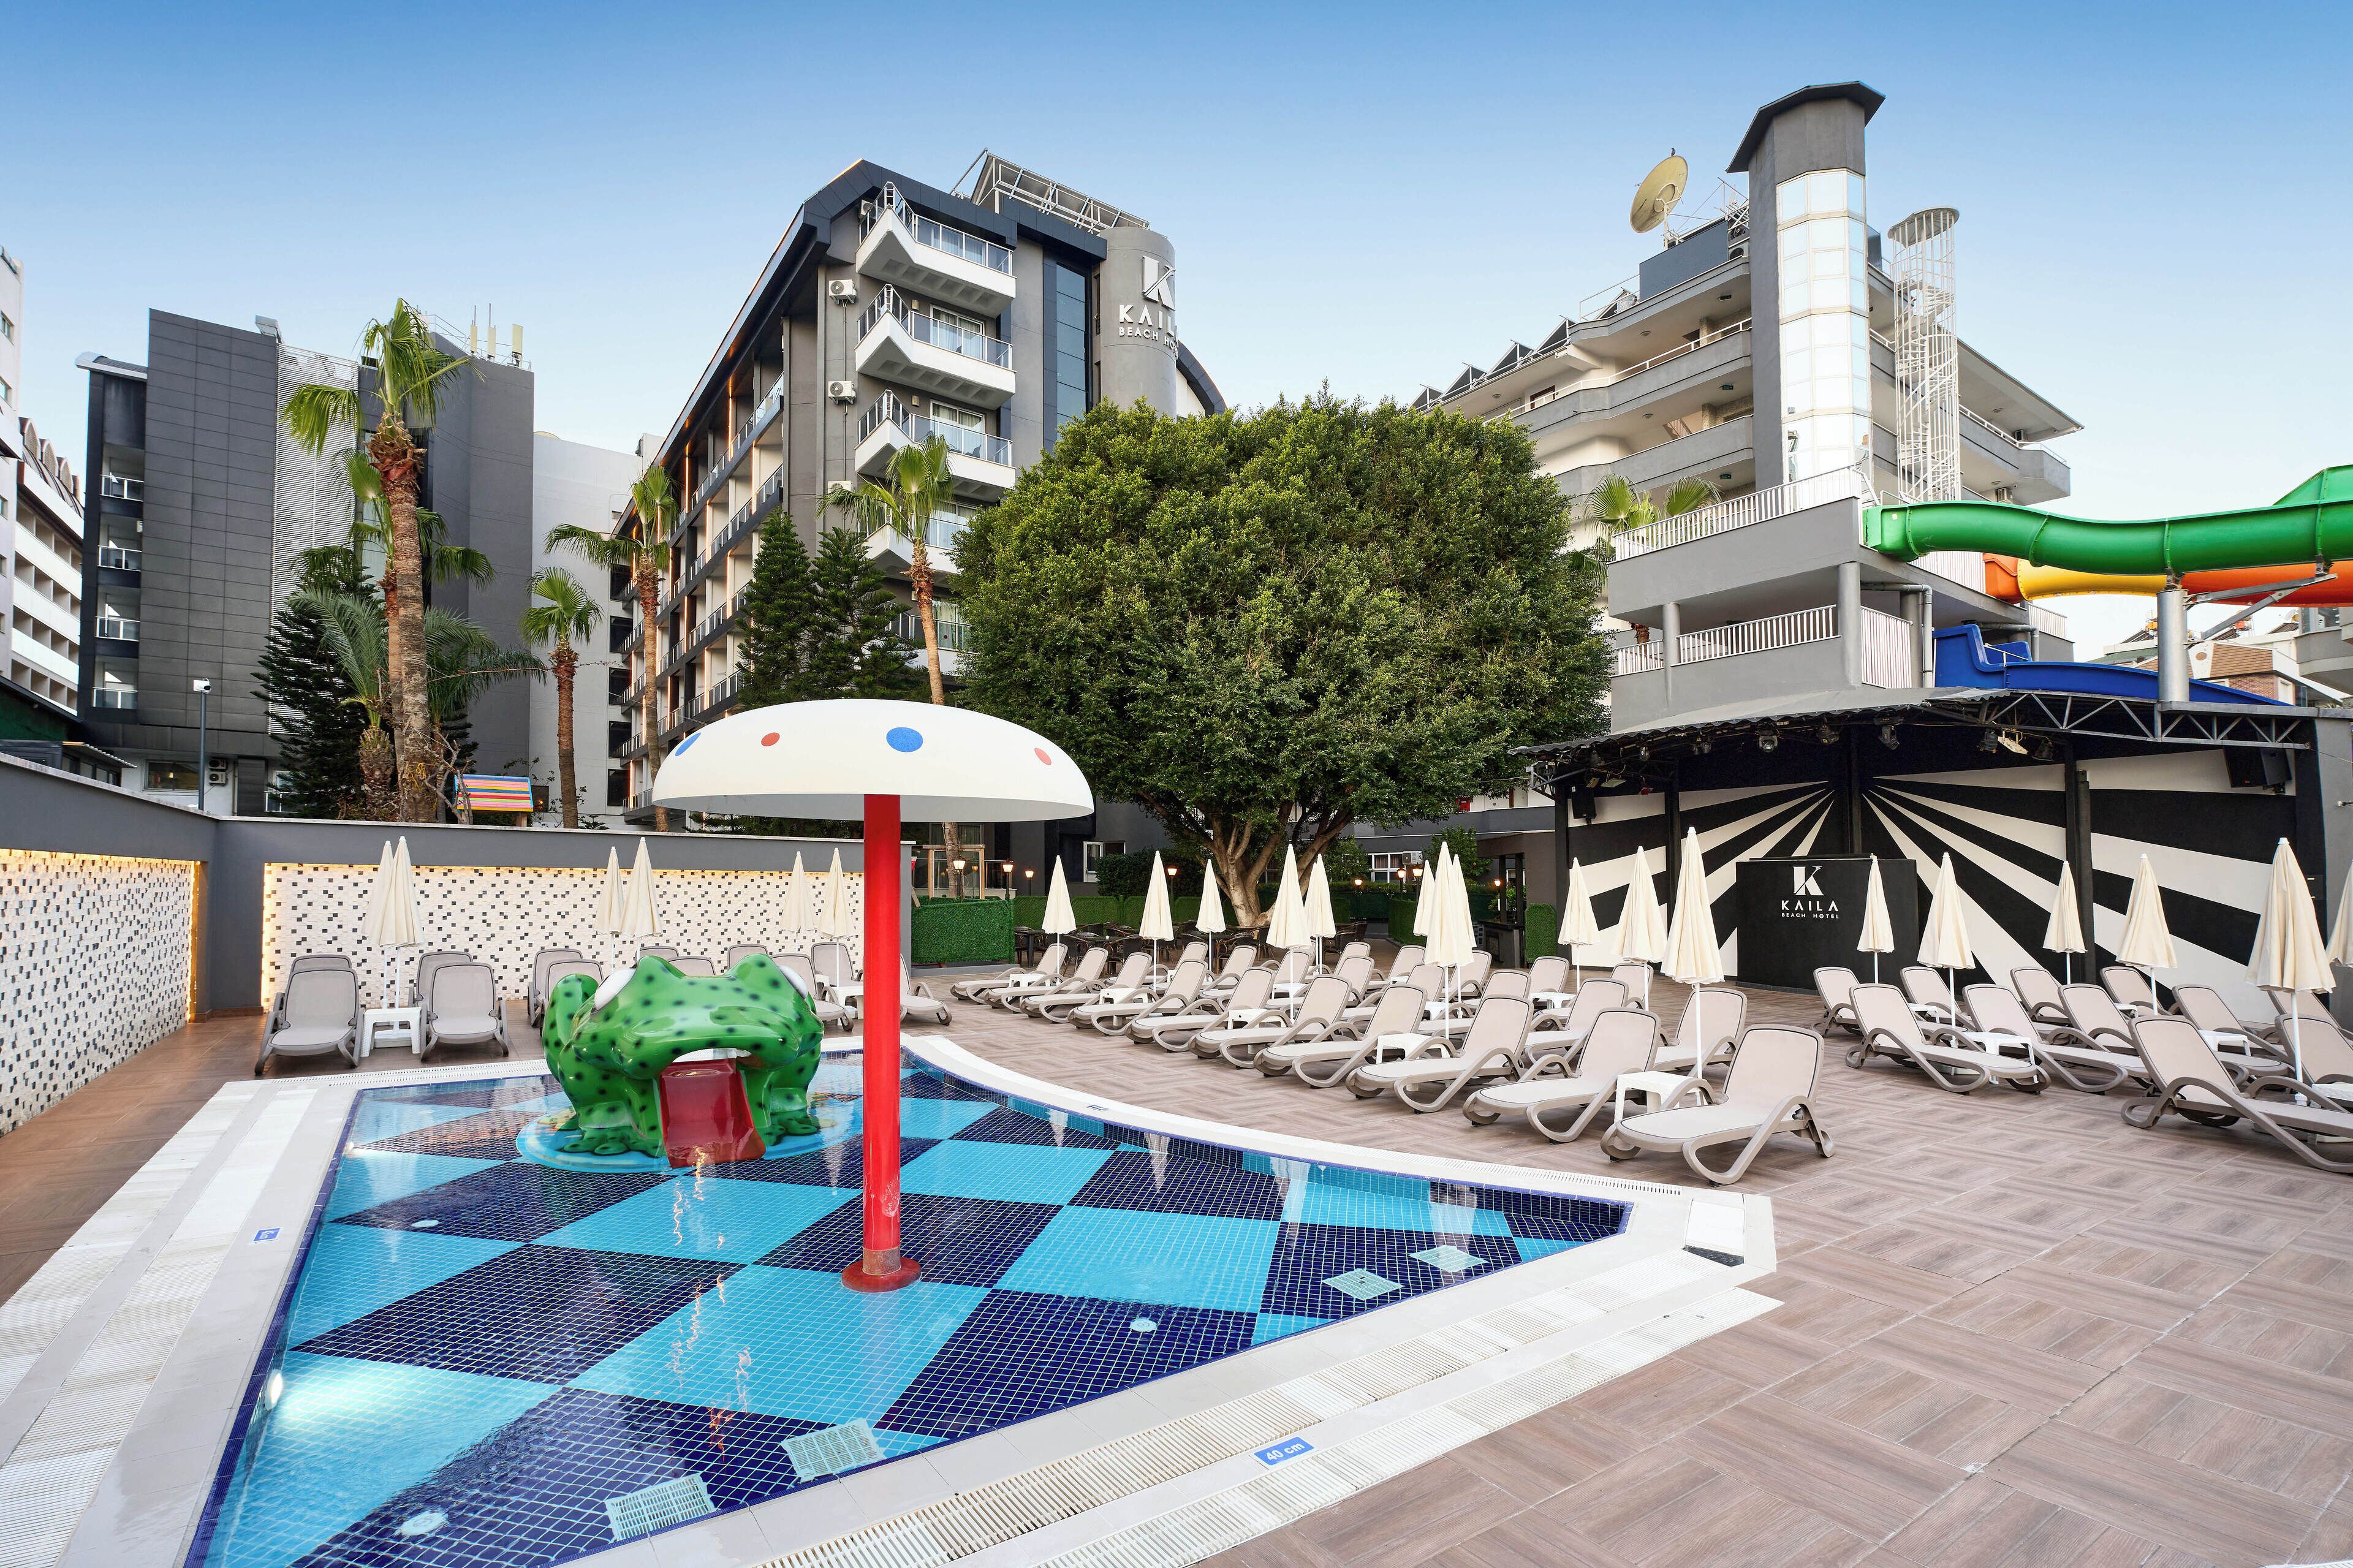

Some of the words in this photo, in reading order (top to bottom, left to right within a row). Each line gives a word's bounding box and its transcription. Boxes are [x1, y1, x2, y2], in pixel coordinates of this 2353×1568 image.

[1142, 256, 1176, 311] K
[1119, 305, 1178, 347] KAIL
[1119, 327, 1158, 341] BEACH
[1793, 866, 1825, 896] K
[1781, 900, 1839, 912] KAILA
[1266, 1450, 1284, 1460] 40
[1284, 1443, 1305, 1454] cm
